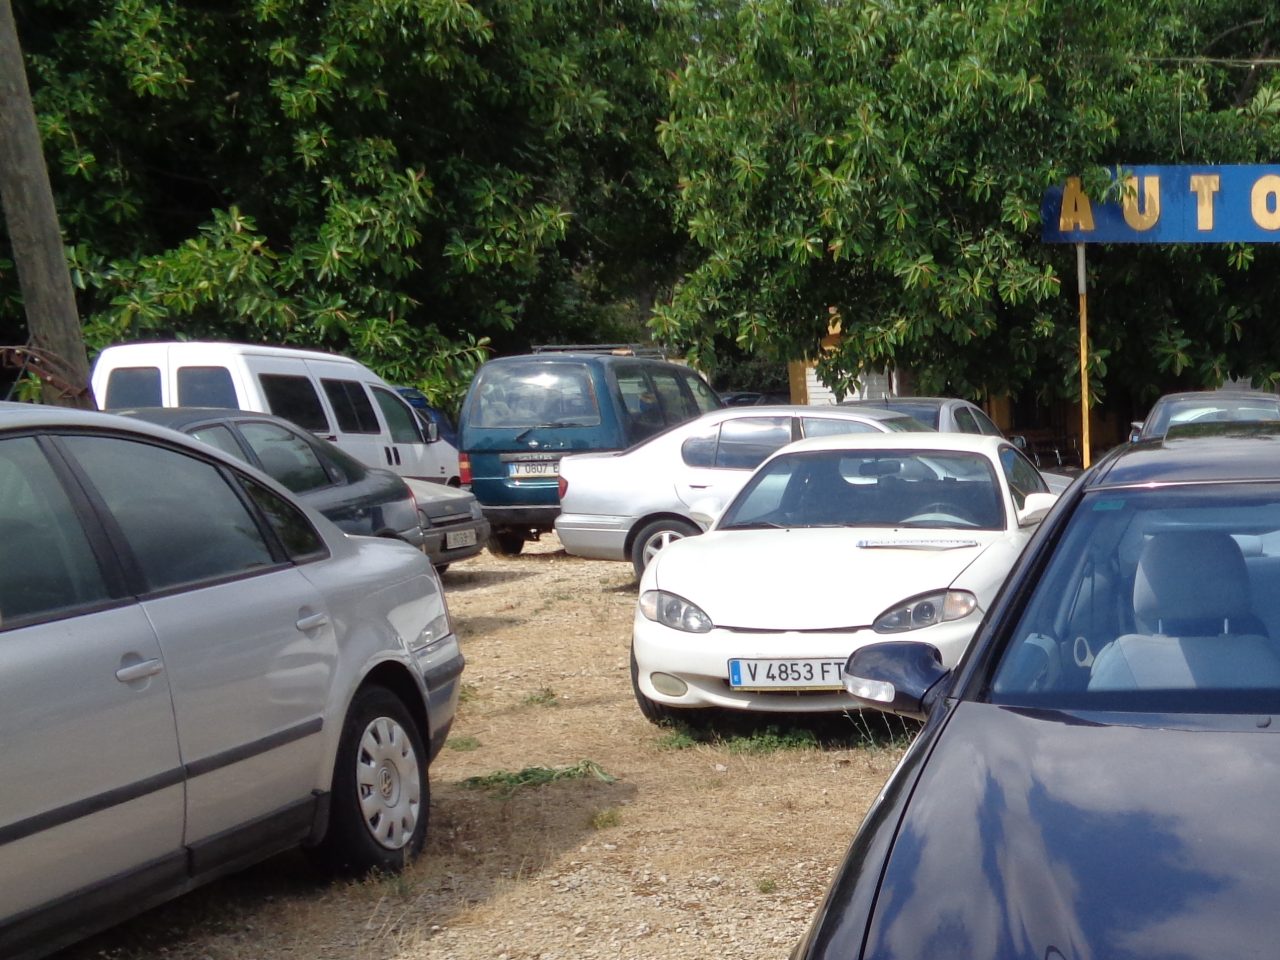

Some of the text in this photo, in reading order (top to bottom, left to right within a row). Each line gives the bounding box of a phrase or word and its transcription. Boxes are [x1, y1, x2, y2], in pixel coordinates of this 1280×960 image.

[747, 662, 845, 682] V 4853 FT
